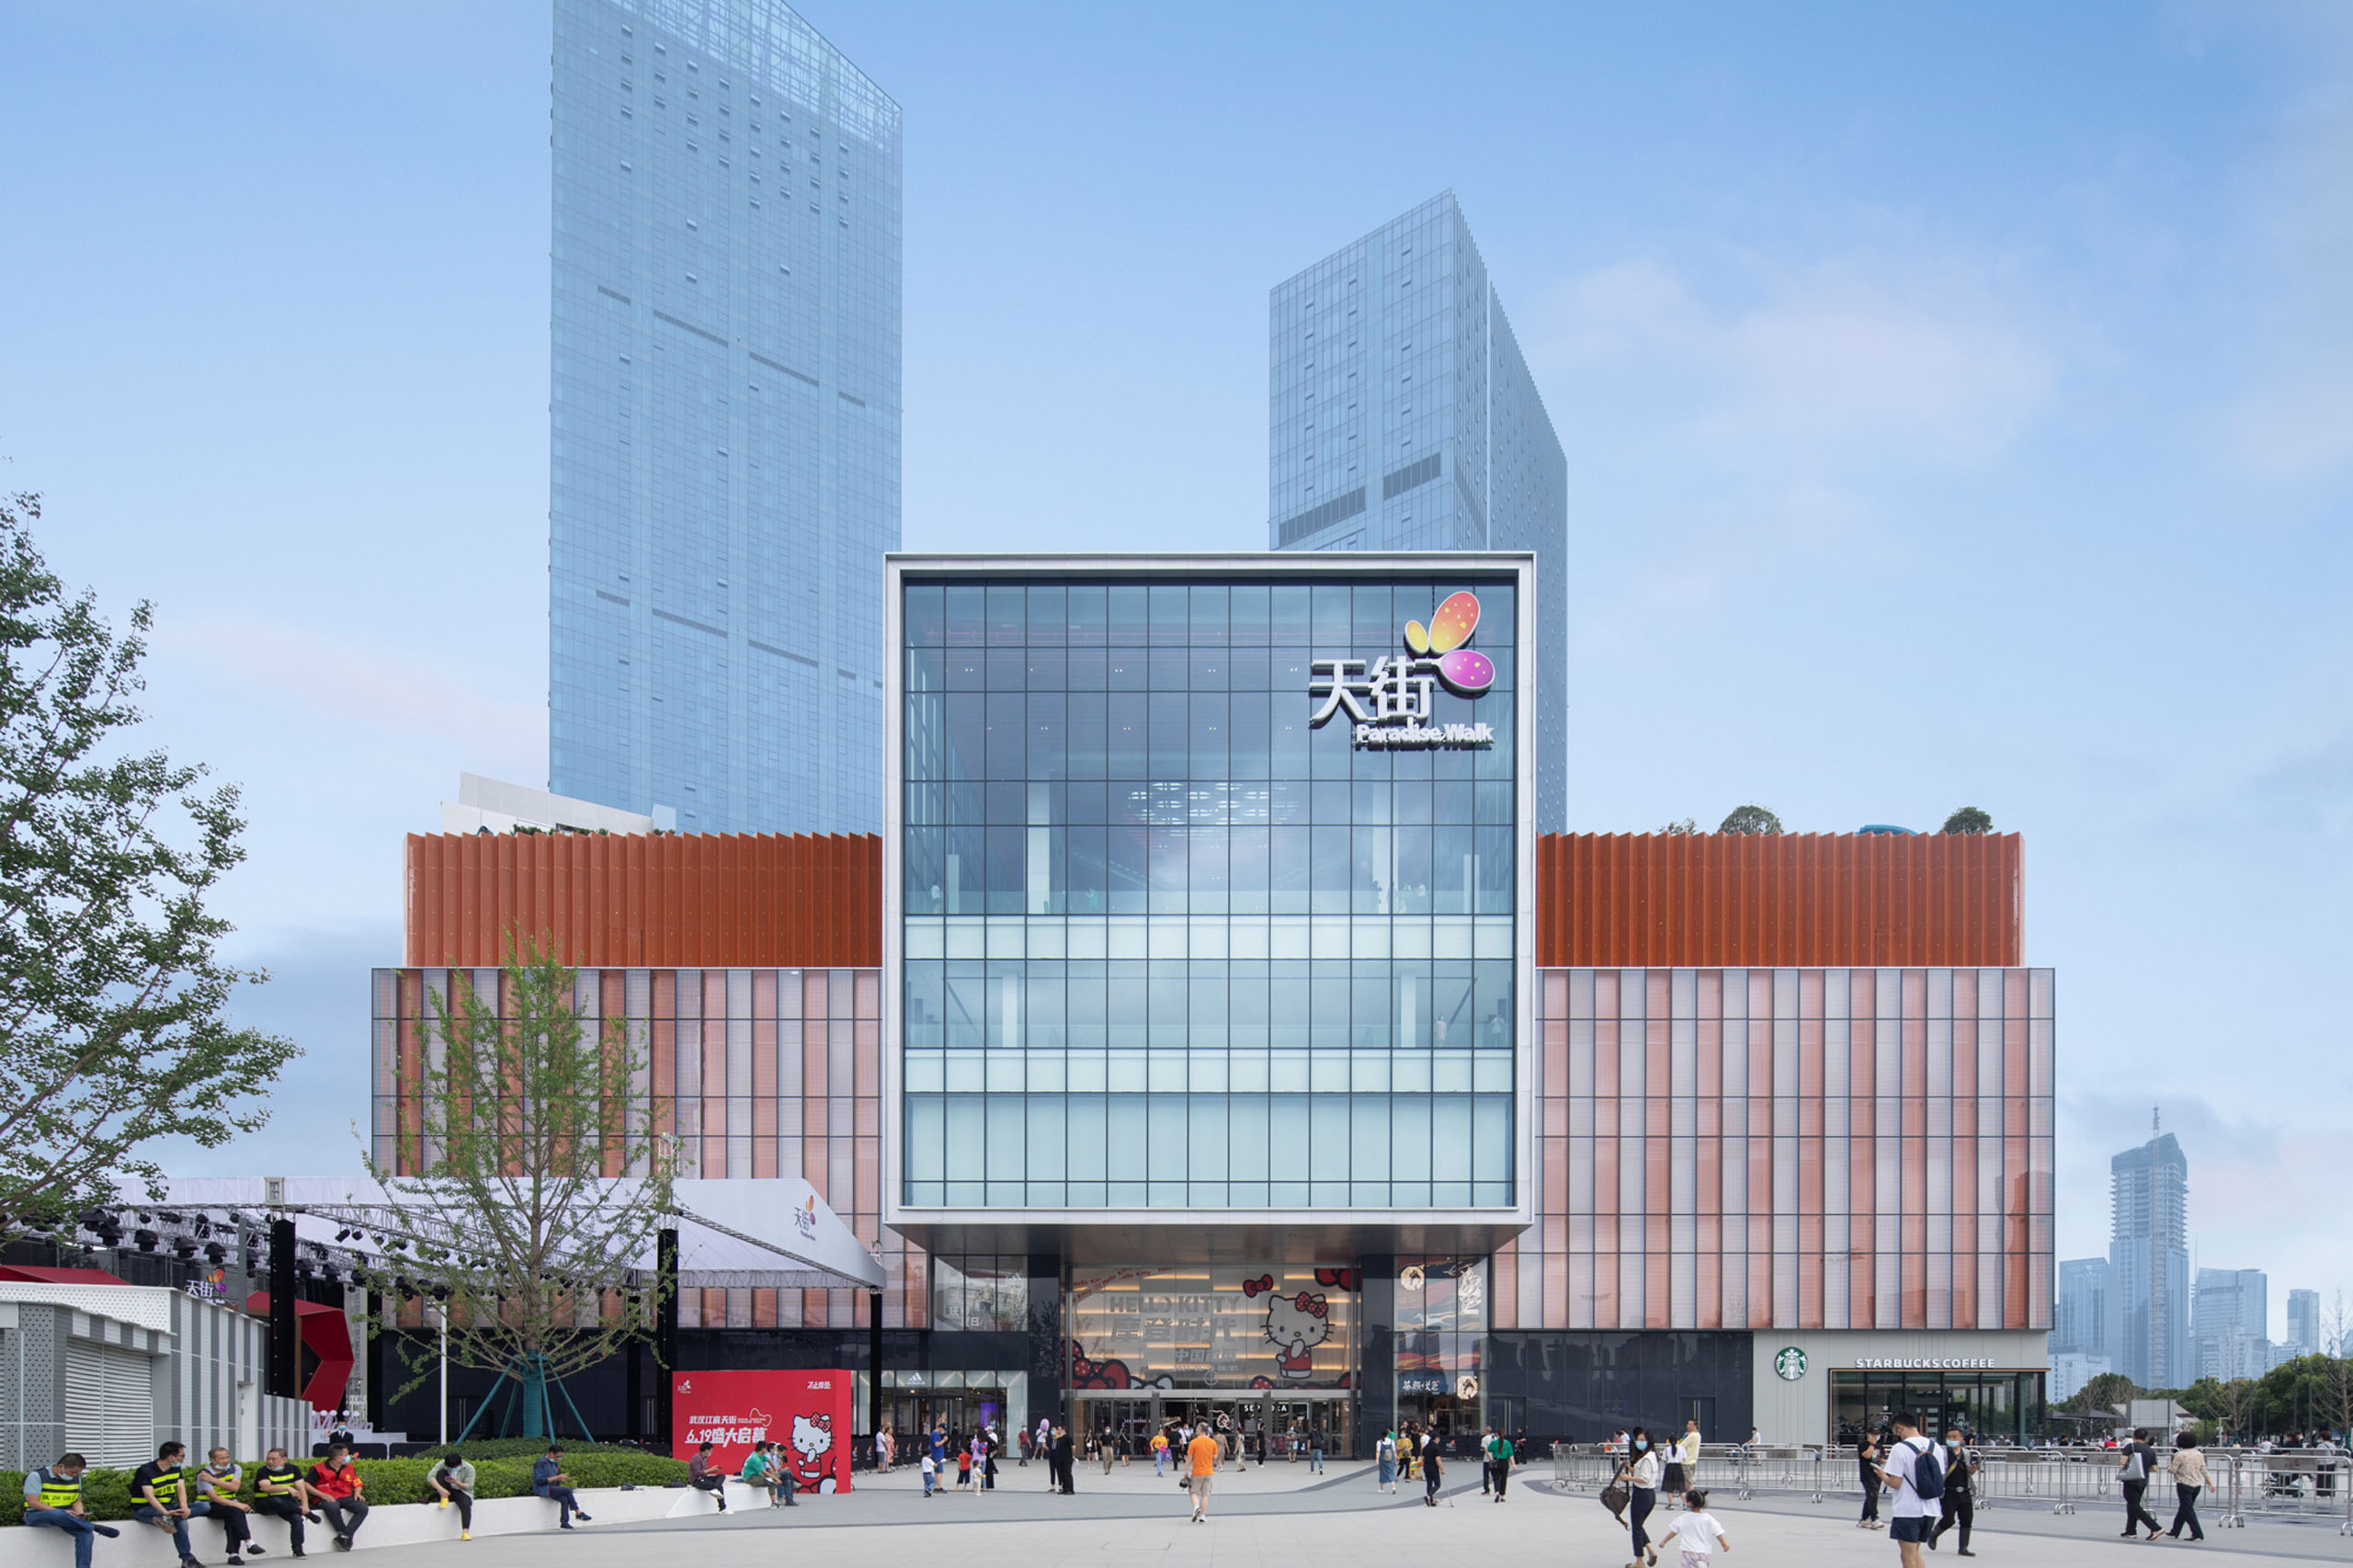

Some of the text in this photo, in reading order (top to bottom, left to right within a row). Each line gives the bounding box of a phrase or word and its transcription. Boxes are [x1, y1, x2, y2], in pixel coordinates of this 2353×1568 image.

[1309, 655, 1435, 722] 天街
[1356, 719, 1495, 744] Paradise Walk
[794, 1207, 810, 1231] 天街
[186, 1279, 213, 1298] 天街
[1109, 1295, 1241, 1313] HELLO KITTY
[1110, 1316, 1238, 1343] 摩登时代
[1856, 1358, 1995, 1369] STARBUCKS COFFEE
[685, 1426, 767, 1448] 6.19盛大启幕
